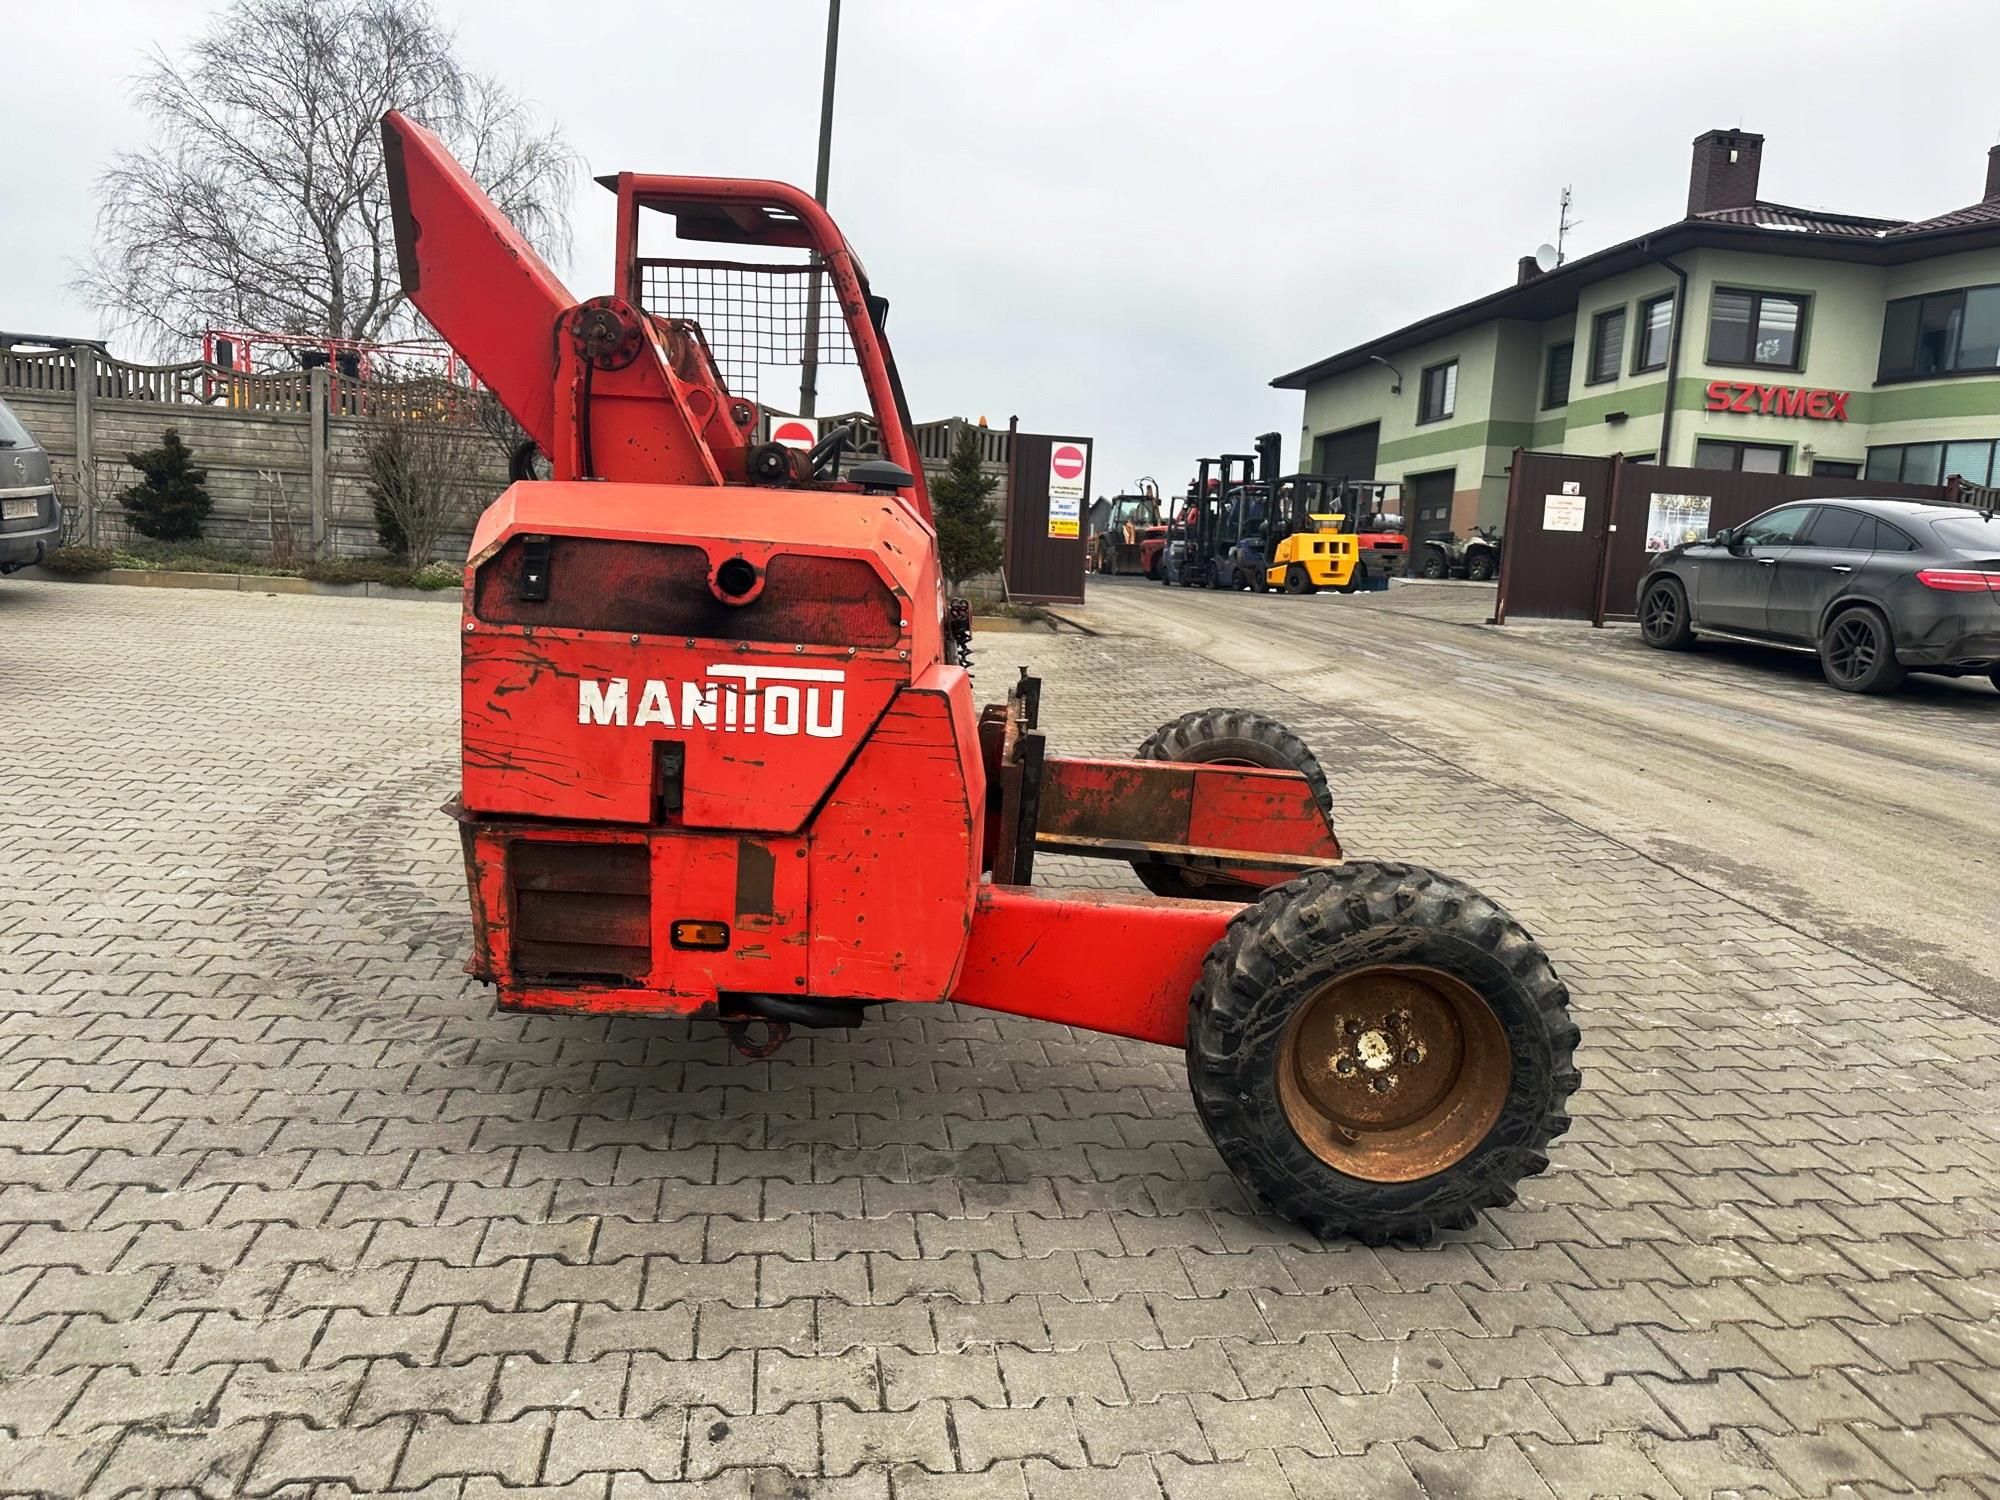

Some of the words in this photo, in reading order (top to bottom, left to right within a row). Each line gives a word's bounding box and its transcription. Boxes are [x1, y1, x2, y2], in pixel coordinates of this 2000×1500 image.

[1705, 381, 1851, 421] SZYMEX
[1653, 495, 1709, 509] SZYMEX
[577, 663, 846, 738] MANITOU
